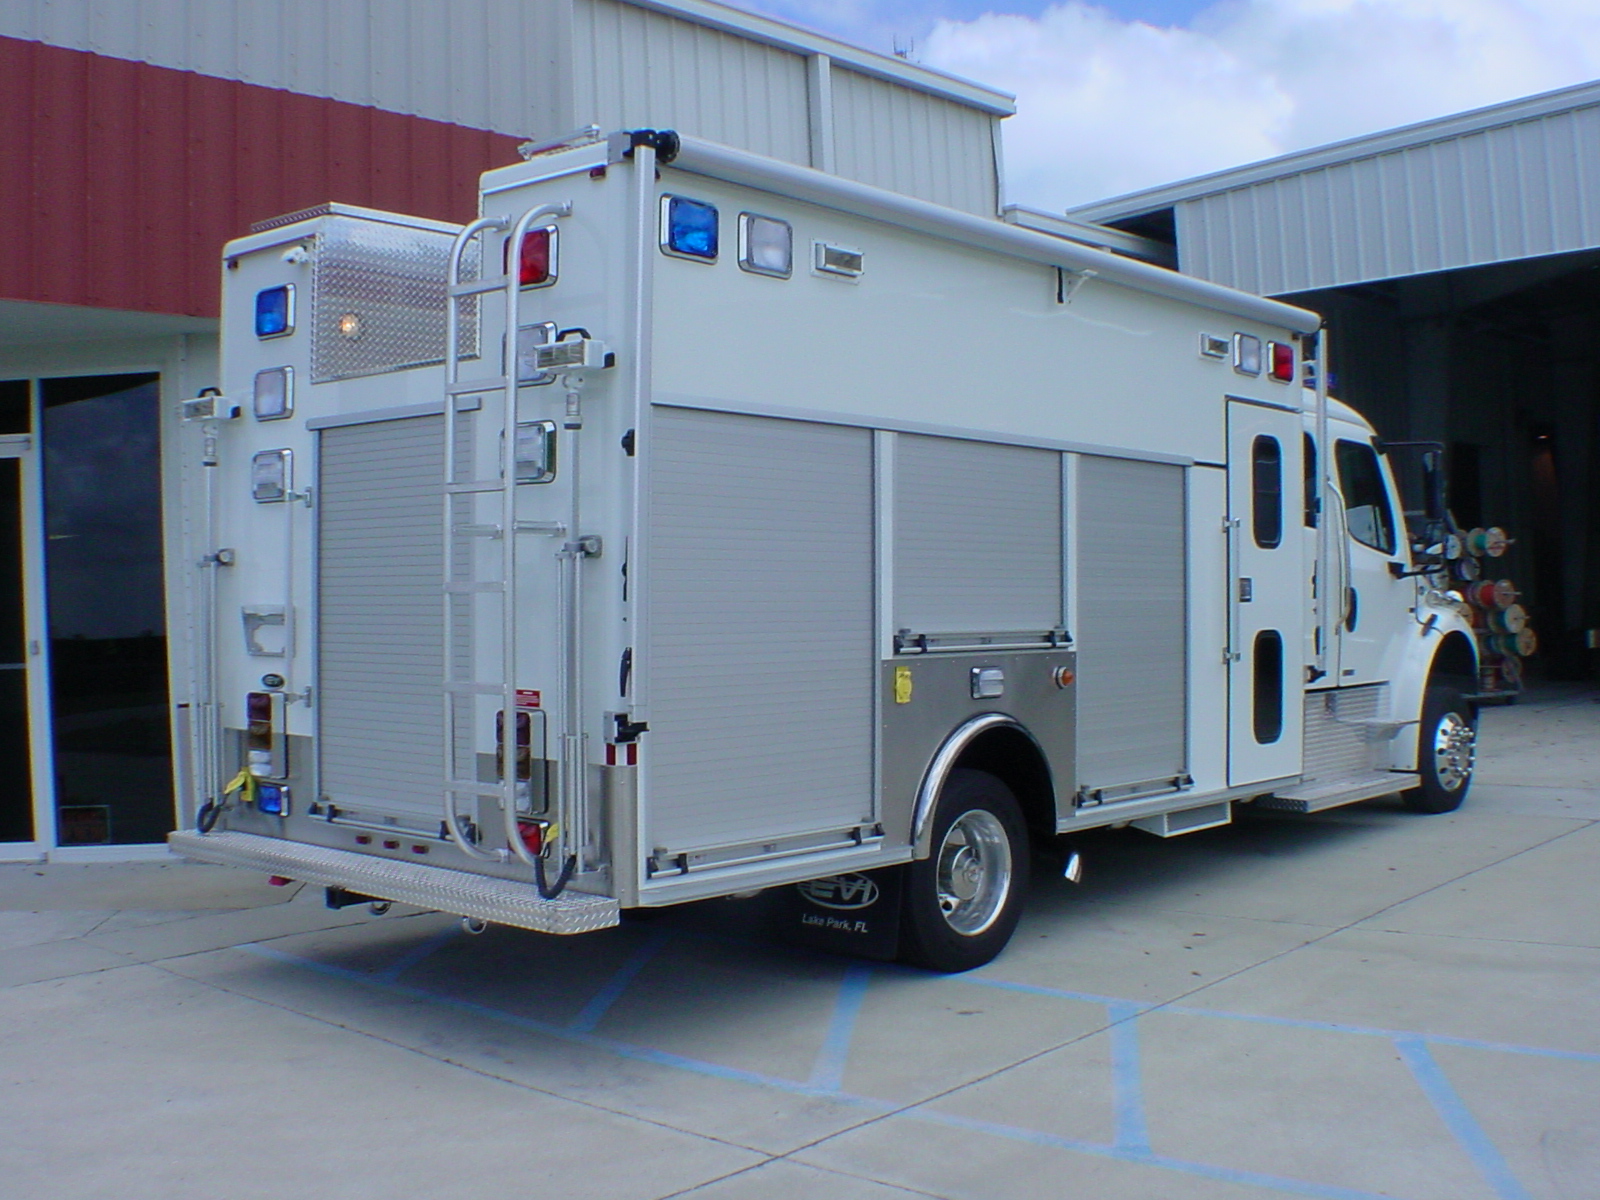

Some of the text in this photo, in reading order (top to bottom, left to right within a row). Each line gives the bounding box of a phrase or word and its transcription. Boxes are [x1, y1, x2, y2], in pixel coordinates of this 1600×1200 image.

[802, 913, 869, 933] Lake Park, FL
